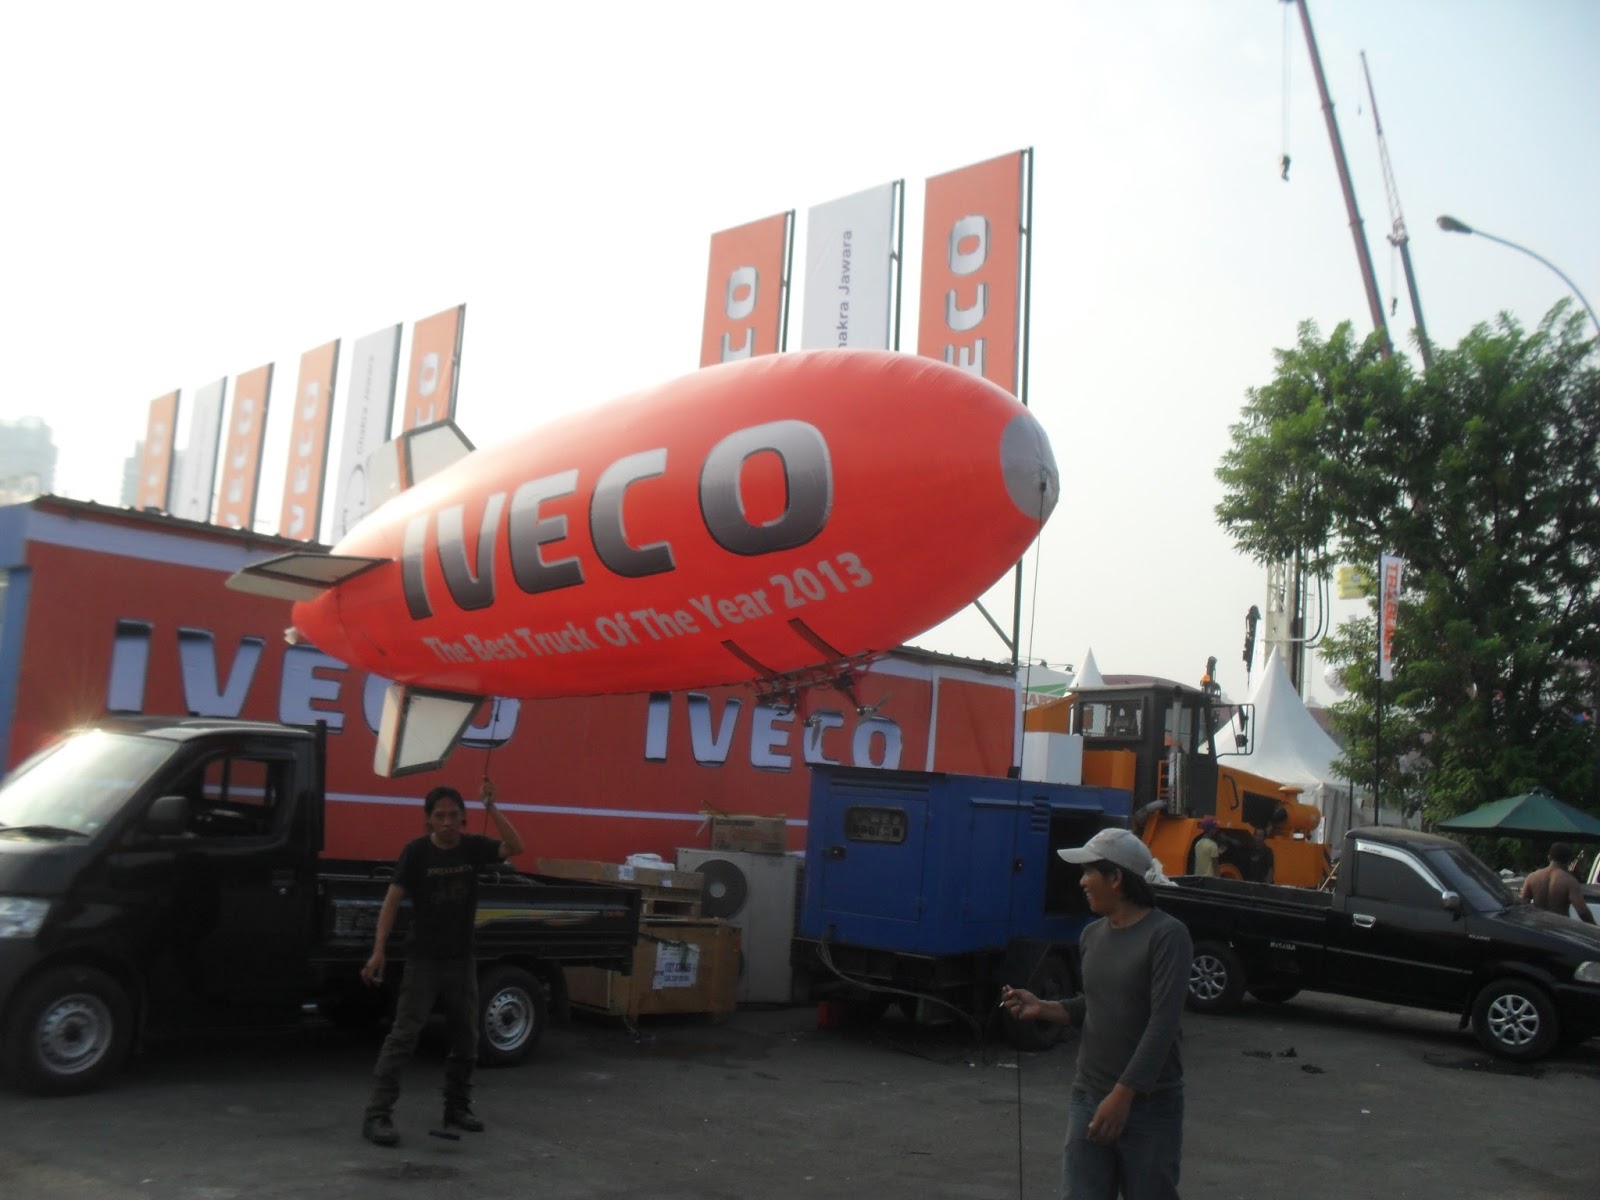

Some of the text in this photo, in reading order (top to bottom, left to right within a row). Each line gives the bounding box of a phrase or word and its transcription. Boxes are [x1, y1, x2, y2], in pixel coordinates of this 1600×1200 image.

[837, 229, 854, 296] Jawara
[401, 419, 834, 621] IVECO
[421, 551, 874, 664] The Best Truck Of The Year 2013
[644, 691, 903, 773] IVECO
